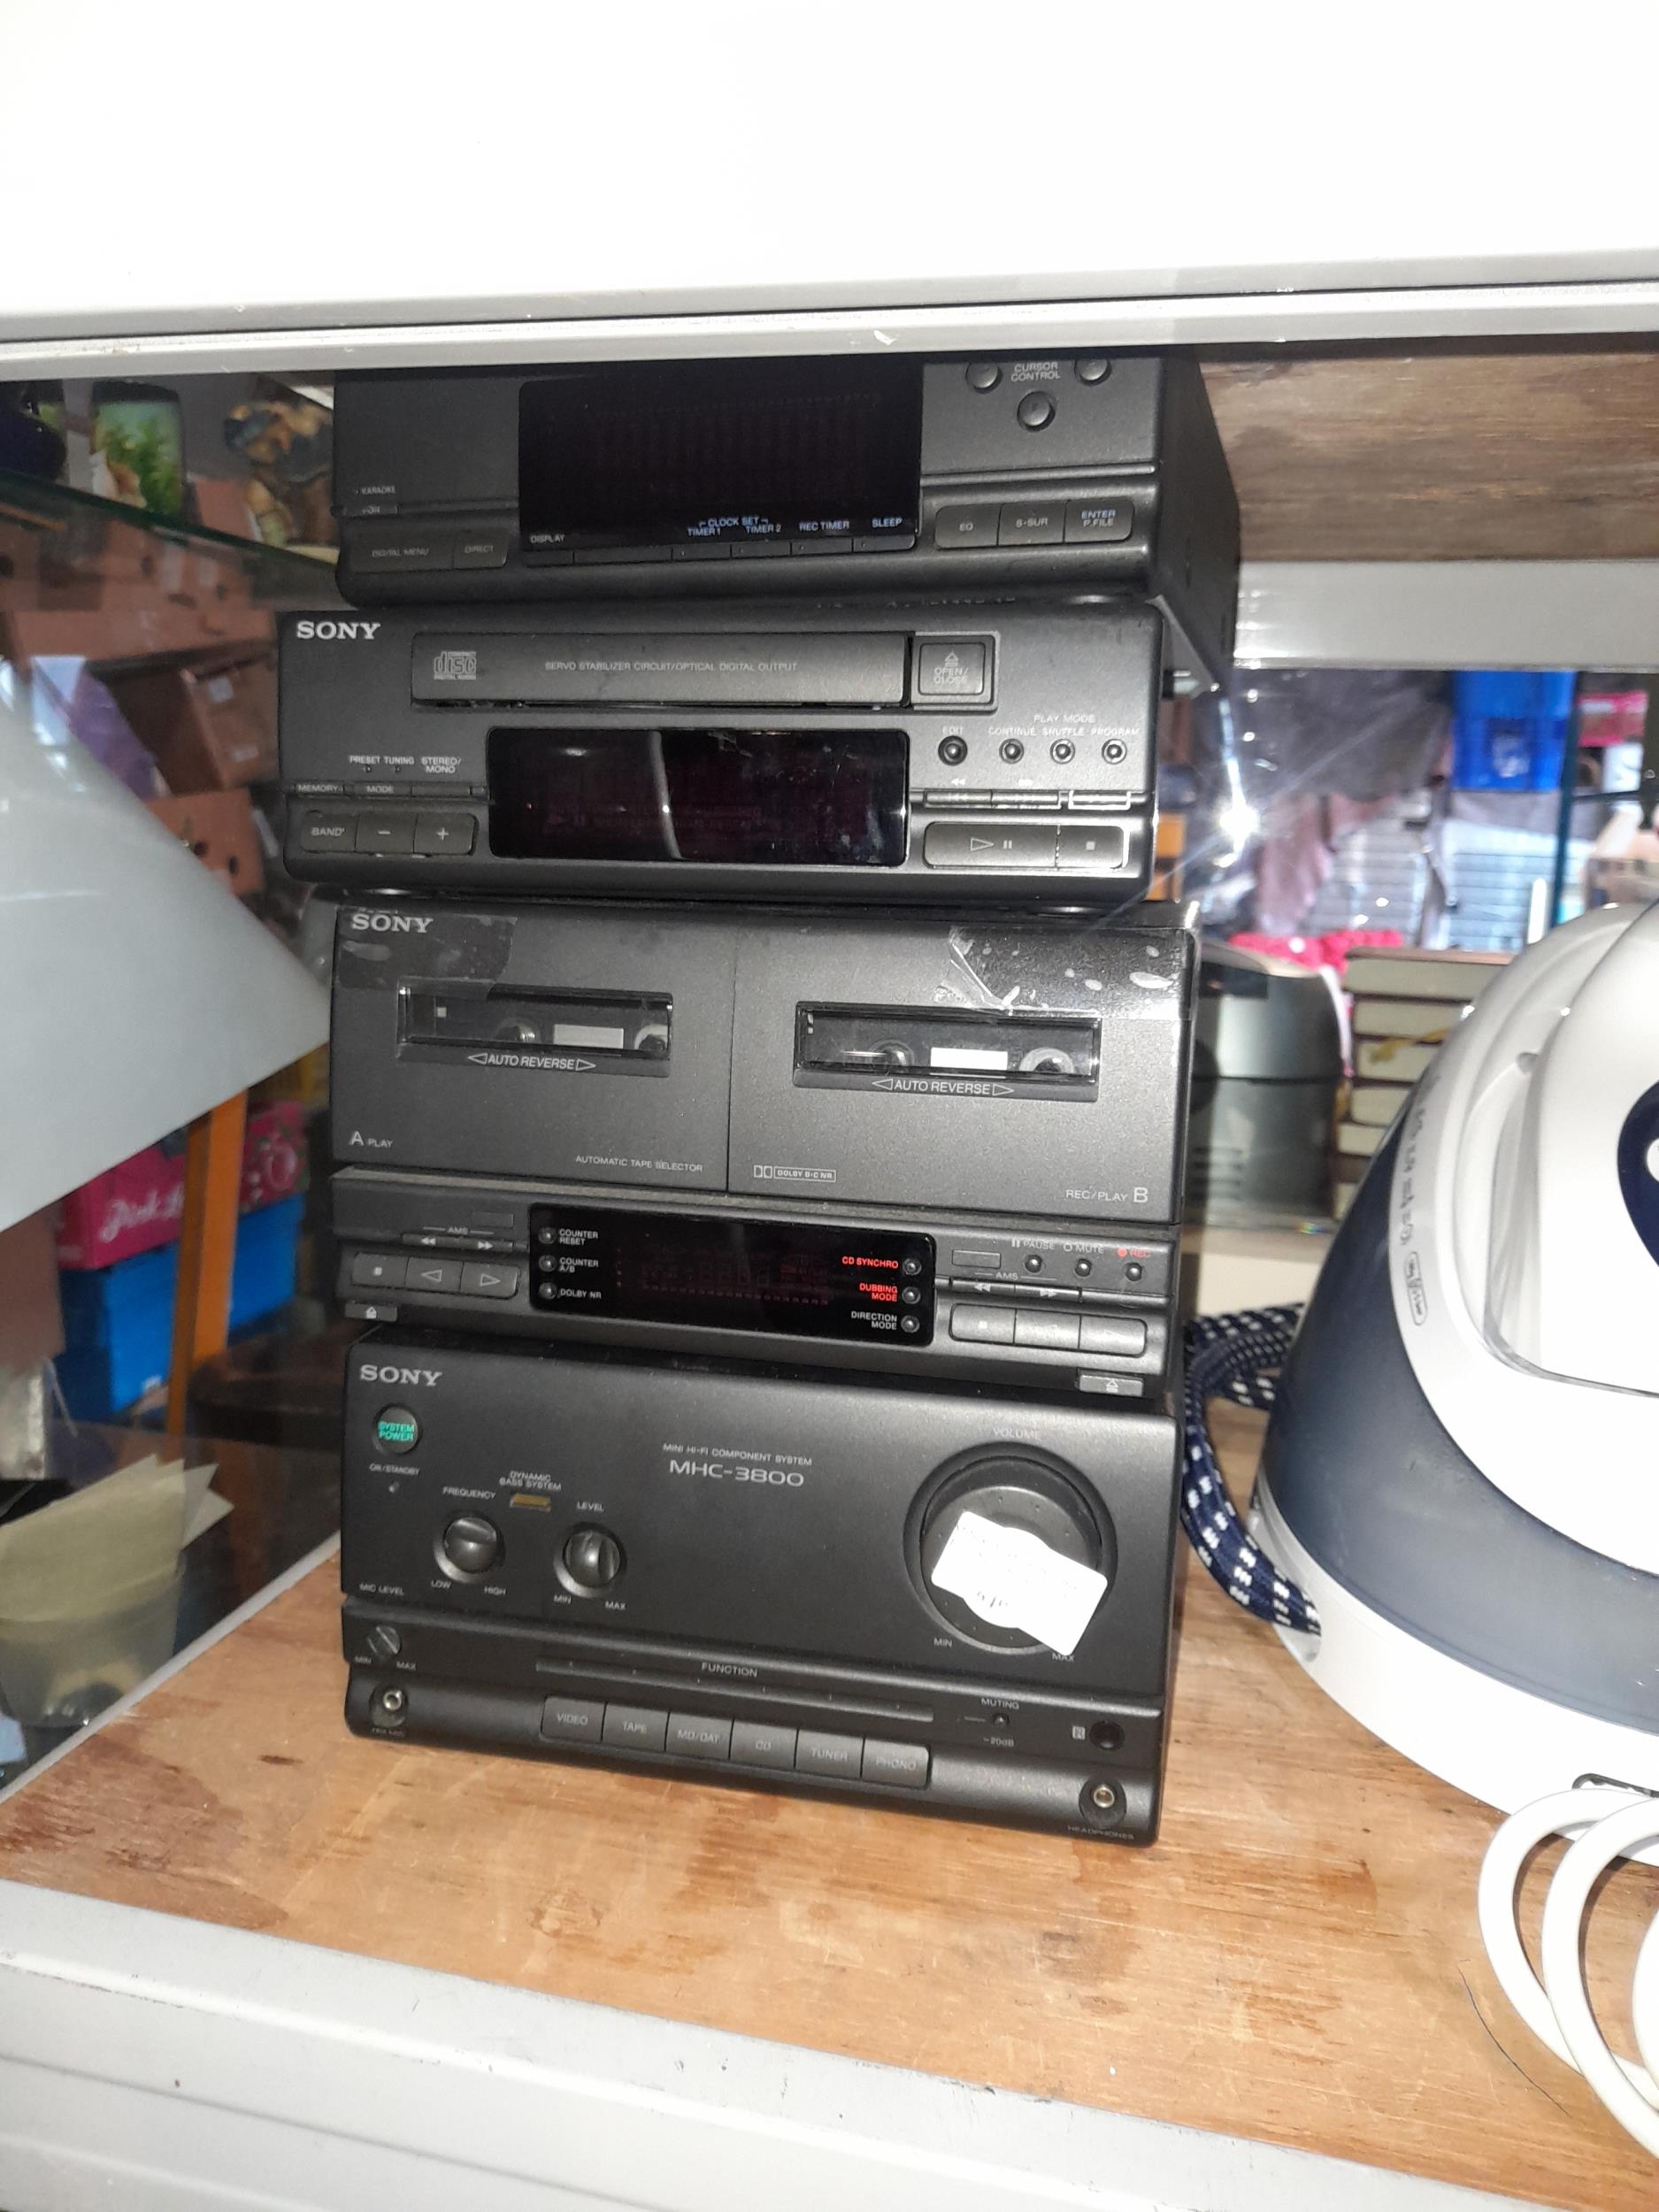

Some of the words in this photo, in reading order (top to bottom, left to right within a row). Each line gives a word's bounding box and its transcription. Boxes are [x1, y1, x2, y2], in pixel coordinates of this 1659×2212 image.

[1014, 362, 1058, 373] CURSOR
[1011, 371, 1061, 382] CONTROL
[1081, 510, 1116, 519] ENTER
[708, 518, 739, 528] CLOCK
[741, 516, 759, 526] SET
[799, 522, 818, 532] REC
[820, 520, 849, 531] TIMER
[872, 517, 903, 528] SLEEP
[687, 527, 716, 537] TIMER
[746, 526, 775, 534] TIMER
[530, 534, 565, 543] DISPLAY
[403, 547, 429, 557] MENU
[465, 544, 494, 555] DIRECT
[296, 620, 380, 640] SONY
[545, 662, 577, 671] SERVO
[579, 662, 631, 672] STABILIZER
[634, 662, 715, 672] CIRCUIT/OPTICAL
[719, 663, 755, 672] DIGITAL
[758, 663, 796, 672] OUTPUT
[933, 667, 969, 677] OPEN/
[933, 676, 967, 685] CLOSE
[942, 726, 964, 735] EDIT
[988, 727, 1036, 736] CONTINUE
[1042, 727, 1084, 736] SHUFFLE
[1090, 727, 1140, 736] PROGRAM
[349, 756, 380, 764] PRESET
[384, 756, 414, 765] TUNING
[421, 757, 462, 765] STEREO/
[426, 765, 456, 774] MONO
[297, 784, 339, 793] MEMORY
[366, 785, 395, 794] MODE
[351, 913, 434, 933] SONY
[488, 1054, 519, 1067] AUTO
[521, 1056, 575, 1070] REVERSE
[894, 1079, 927, 1093] AUTO
[930, 1081, 991, 1095] REVERSE
[349, 1131, 364, 1146] A
[368, 1139, 394, 1148] PLAY
[575, 1155, 628, 1167] AUTOMATIC
[631, 1158, 652, 1169] TAPE
[656, 1160, 703, 1172] SELECTOR
[777, 1169, 803, 1178] DOLBY
[1065, 1188, 1128, 1202] REC/PLAY
[1133, 1187, 1148, 1203] B
[448, 1226, 469, 1235] AMS
[559, 1228, 598, 1240] COUNTER
[559, 1237, 585, 1247] RESET
[1024, 1240, 1056, 1250] PAUSE
[1075, 1243, 1104, 1254] MUTE
[1130, 1249, 1151, 1258] REC
[559, 1257, 599, 1268] COUNTER
[841, 1256, 854, 1265] CD
[856, 1256, 899, 1269] SYNCHRO
[559, 1264, 575, 1273] A/B
[995, 1271, 1018, 1281] AMS
[560, 1288, 587, 1299] DOLBY
[589, 1290, 602, 1300] NR
[859, 1283, 898, 1294] DUBBING
[872, 1292, 898, 1302] MODE
[851, 1311, 898, 1323] DIRECTION
[872, 1320, 898, 1331] MODE
[359, 1364, 442, 1386] SONY
[378, 1421, 415, 1432] SYSTEM
[378, 1430, 414, 1441] POWER
[664, 1443, 683, 1452] MINI
[687, 1446, 709, 1455] HI-FI
[711, 1448, 772, 1462] COMPONENT
[775, 1455, 812, 1466] SYSTEM
[510, 1471, 551, 1482] DYNAMIC
[669, 1459, 804, 1487] MHC-3800
[499, 1477, 523, 1488] BASS
[526, 1479, 562, 1491] SYSTEM
[443, 1486, 495, 1500] FREQUENCY
[577, 1502, 604, 1512] LEVEL
[359, 1583, 376, 1593] MIC
[379, 1585, 404, 1596] LEVEL
[431, 1579, 451, 1589] LOW
[484, 1586, 506, 1595] HIGH
[554, 1594, 572, 1604] MIN
[605, 1601, 626, 1610] MAX
[933, 1638, 953, 1647] MIN
[396, 1661, 417, 1671] MAX
[702, 1662, 758, 1678] FUNCTION
[981, 1697, 1019, 1710] MUTING
[557, 1712, 588, 1725] VIDEO
[624, 1721, 647, 1734] TAPE
[678, 1729, 719, 1744] MD/DAT
[756, 1740, 771, 1751] CD
[810, 1747, 848, 1762] TUNER
[876, 1756, 917, 1770] PHONO
